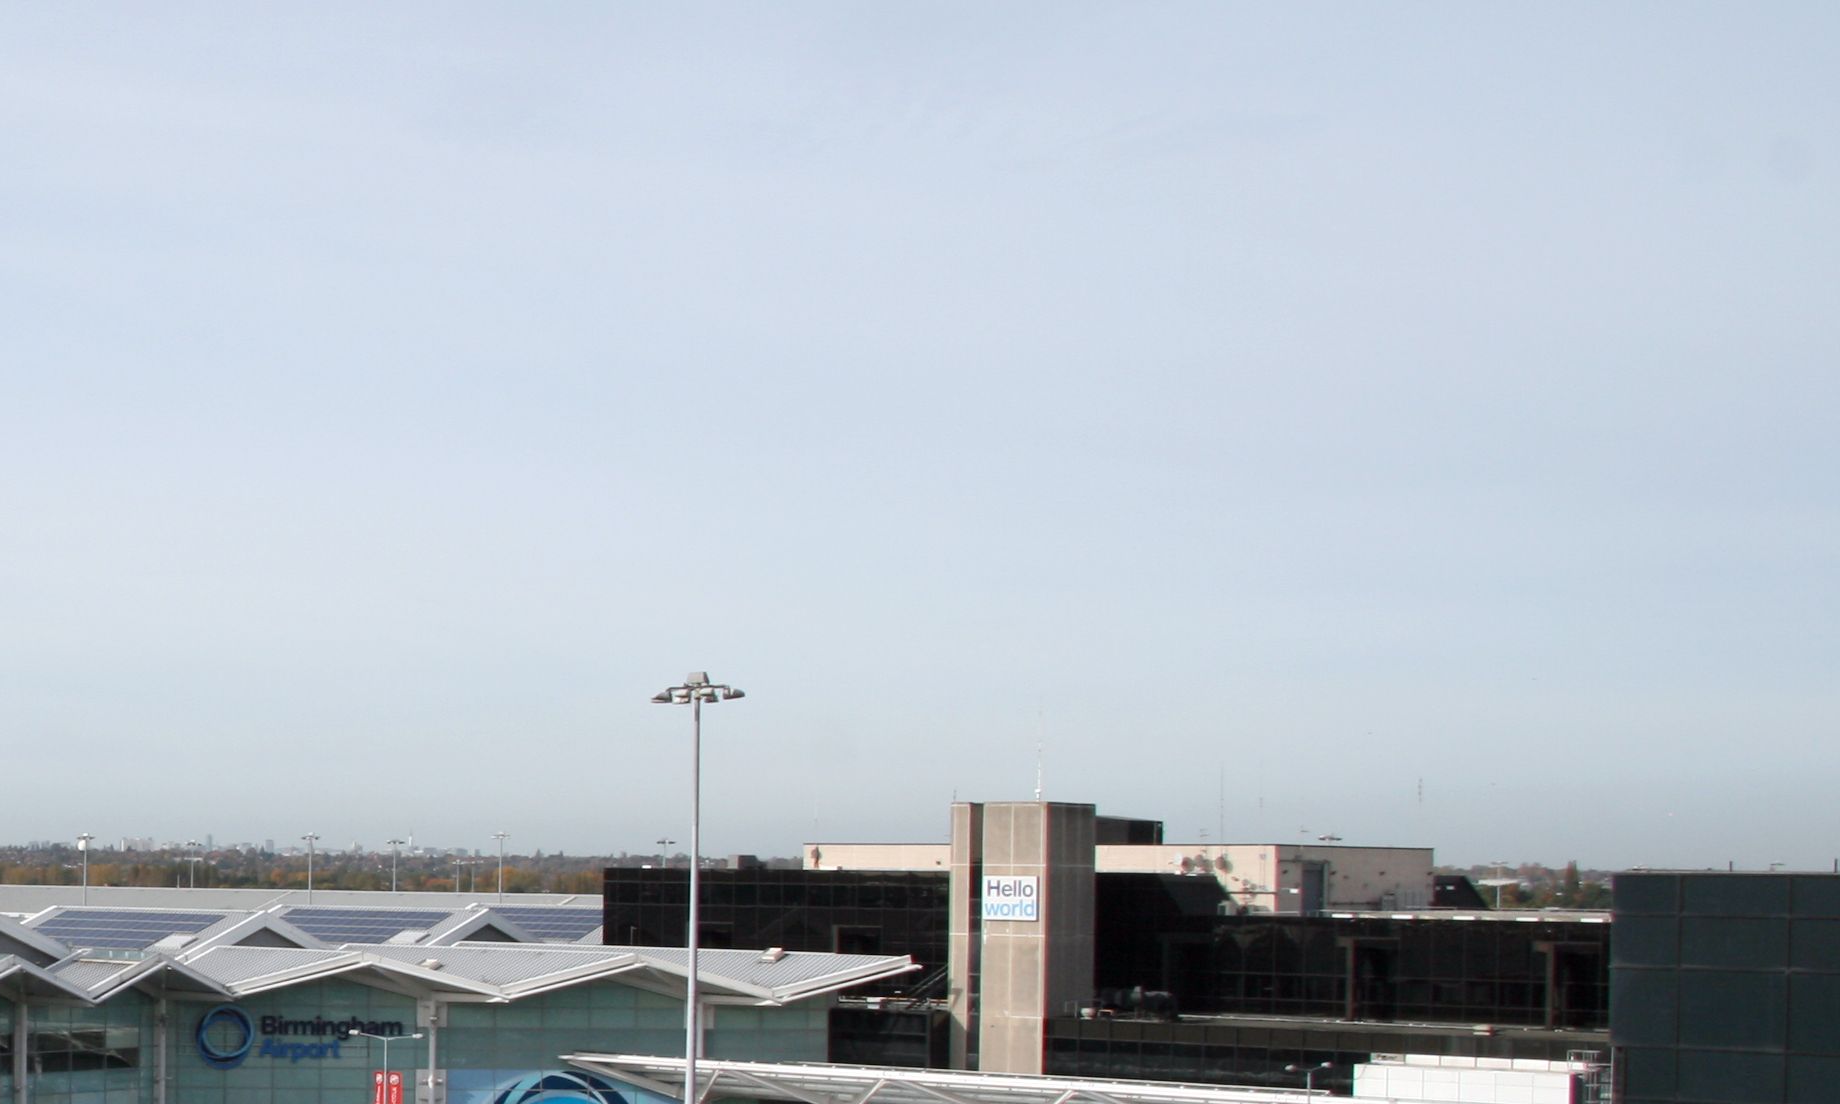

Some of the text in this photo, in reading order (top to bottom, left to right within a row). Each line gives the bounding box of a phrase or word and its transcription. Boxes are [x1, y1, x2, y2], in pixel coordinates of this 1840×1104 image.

[986, 878, 1035, 898] Hello
[984, 898, 1035, 918] world
[260, 1014, 403, 1042] Birmingham
[259, 1037, 341, 1064] Airport
